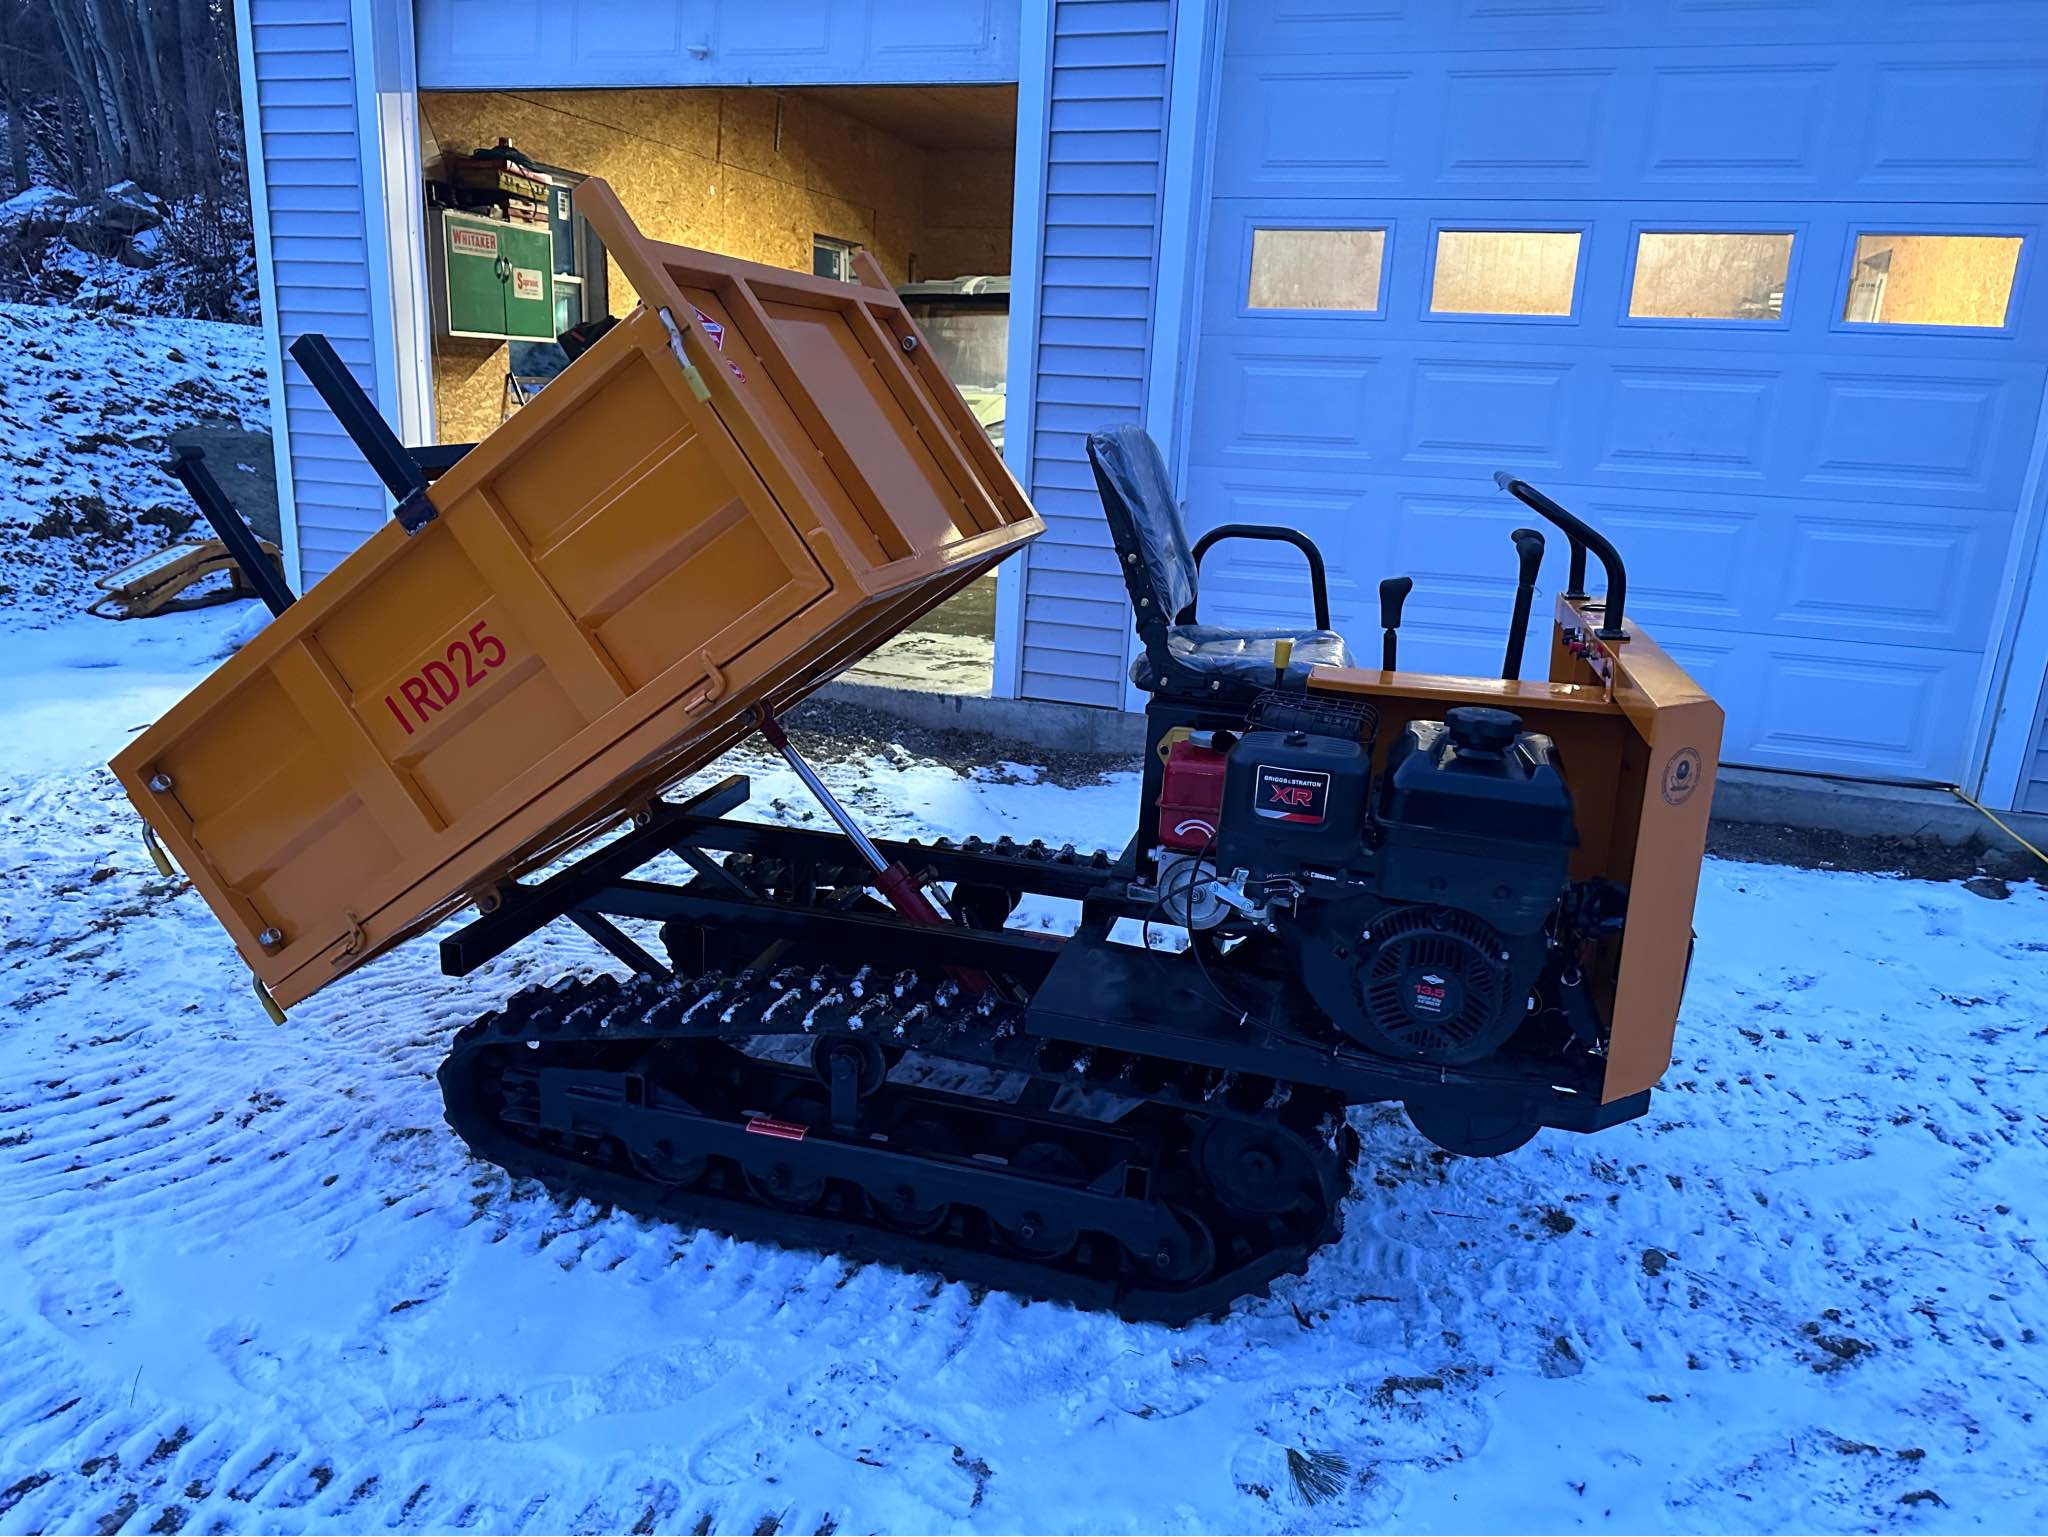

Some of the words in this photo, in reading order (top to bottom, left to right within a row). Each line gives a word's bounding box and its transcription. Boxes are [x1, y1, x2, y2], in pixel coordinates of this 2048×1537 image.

[453, 228, 496, 250] WHITAKER
[384, 620, 506, 735] IRD25
[1269, 784, 1313, 807] XR
[1413, 984, 1446, 999] 13.5
